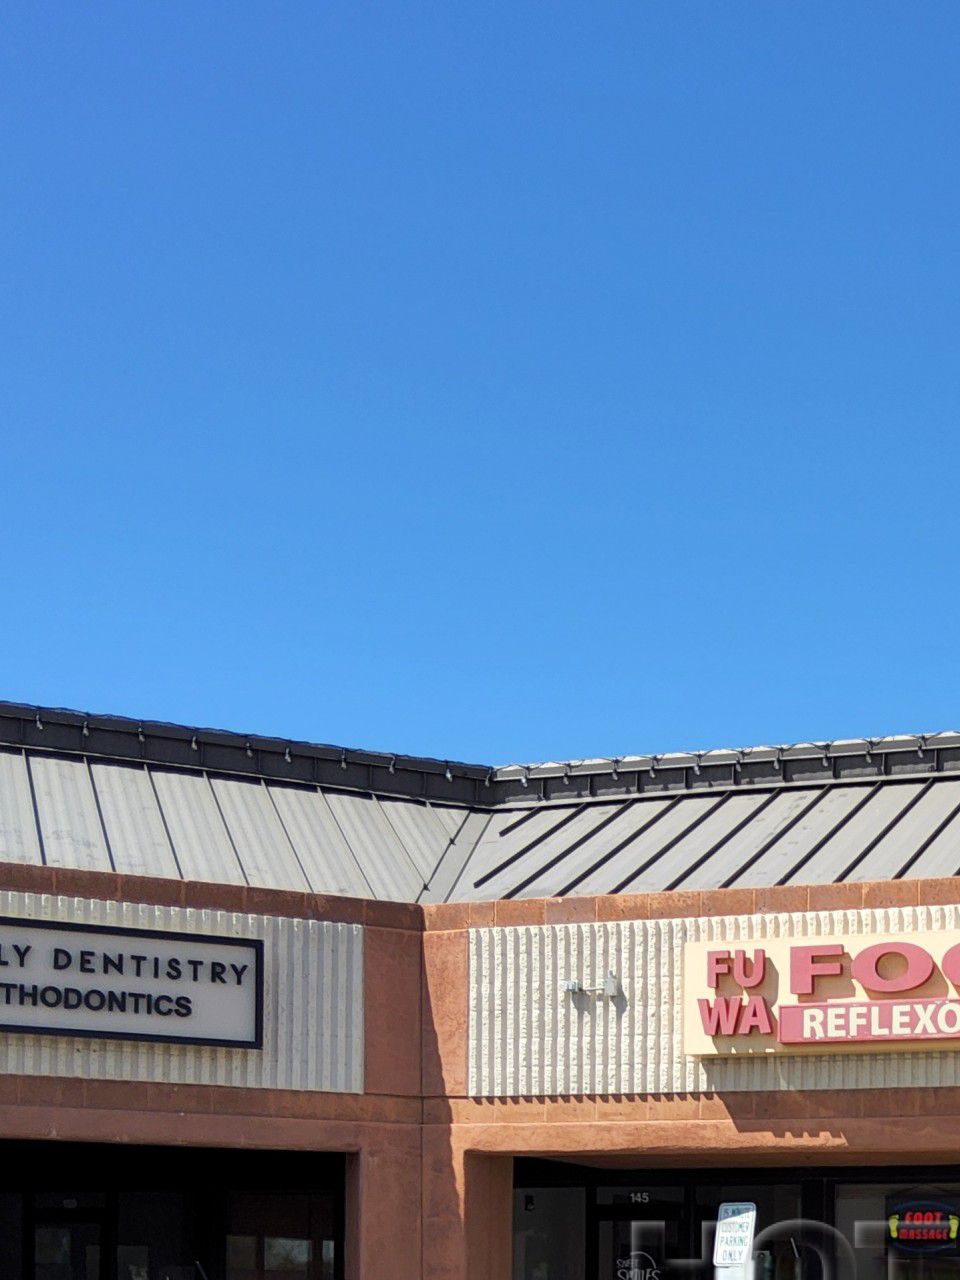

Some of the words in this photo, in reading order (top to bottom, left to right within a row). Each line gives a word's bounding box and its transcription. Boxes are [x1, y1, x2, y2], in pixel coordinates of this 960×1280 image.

[53, 948, 248, 985] DENTISTRY
[707, 949, 767, 988] FU
[0, 982, 192, 1017] THODONTICS
[697, 995, 772, 1036] WA
[630, 1192, 649, 1203] 145
[905, 1211, 943, 1225] FOOT
[720, 1235, 748, 1247] PARKING
[722, 1249, 744, 1262] ONLY
